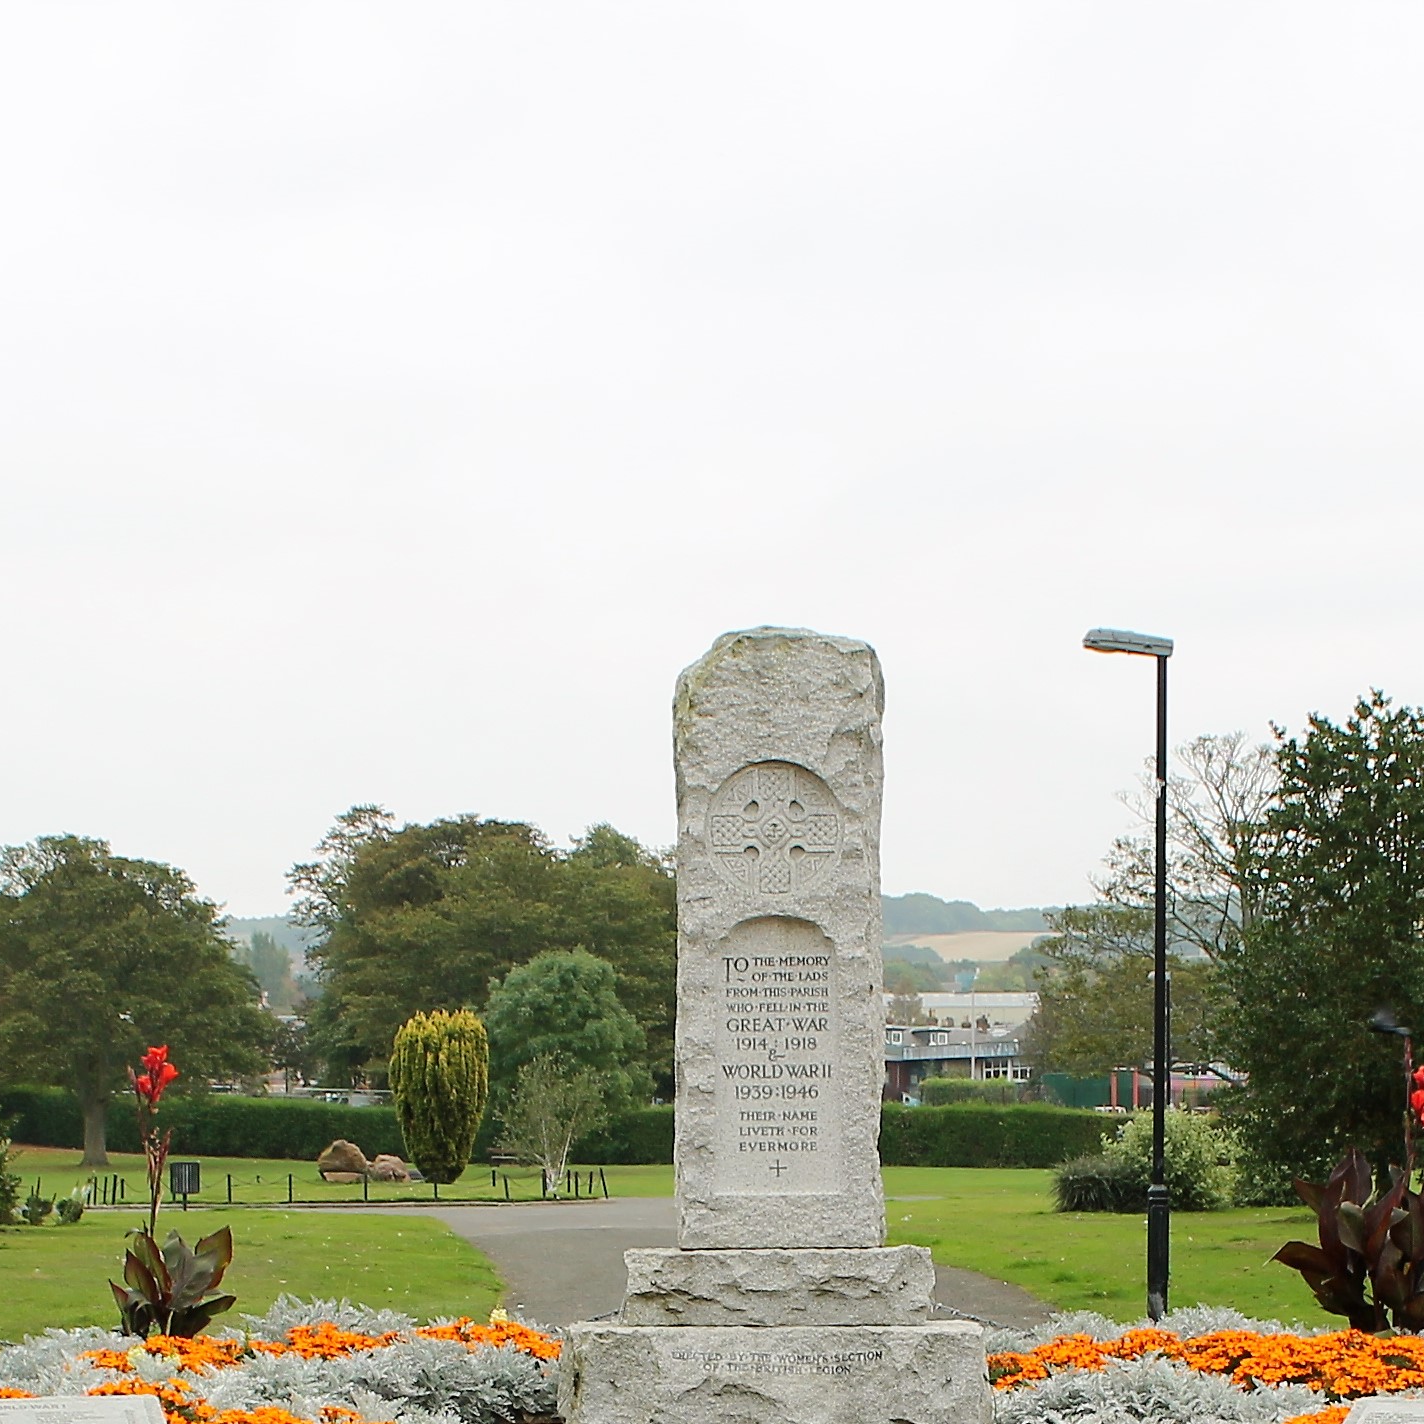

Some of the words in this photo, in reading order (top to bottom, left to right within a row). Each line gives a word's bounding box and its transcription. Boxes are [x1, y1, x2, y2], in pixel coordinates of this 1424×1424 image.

[722, 957, 749, 982] TO
[752, 957, 775, 967] THE
[779, 956, 830, 967] MEMORY
[752, 972, 767, 981] OF
[773, 972, 794, 981] THE
[799, 972, 828, 981] LADS
[726, 987, 758, 997] FROM
[763, 987, 787, 997] THIS
[791, 987, 829, 997] PARISH
[726, 1003, 753, 1013] WHO
[759, 1003, 785, 1012] FELL
[790, 1003, 801, 1012] IN
[806, 1003, 829, 1012] THE
[726, 1018, 785, 1032] GREAT
[792, 1018, 829, 1032] WAR
[736, 1038, 767, 1050] 1914
[785, 1037, 817, 1050] 1918
[769, 1049, 785, 1061] &
[721, 1064, 783, 1079] WORLD
[784, 1064, 819, 1078] WAR
[822, 1064, 832, 1078] II
[736, 1085, 773, 1099] 1939
[781, 1085, 819, 1099] 1946
[739, 1111, 776, 1121] THEIR
[782, 1111, 818, 1121] NAME
[739, 1126, 784, 1136] LIVETH
[792, 1126, 818, 1136] FOR
[739, 1141, 818, 1152] EVERMORE
[671, 1352, 723, 1361] ERECTED
[729, 1352, 744, 1361] BY
[749, 1352, 771, 1362] THE
[833, 1351, 883, 1362] SECTION
[703, 1363, 719, 1372] OF
[726, 1363, 749, 1372] THE
[756, 1363, 802, 1375] BRITISH
[809, 1364, 851, 1375] LEGION
